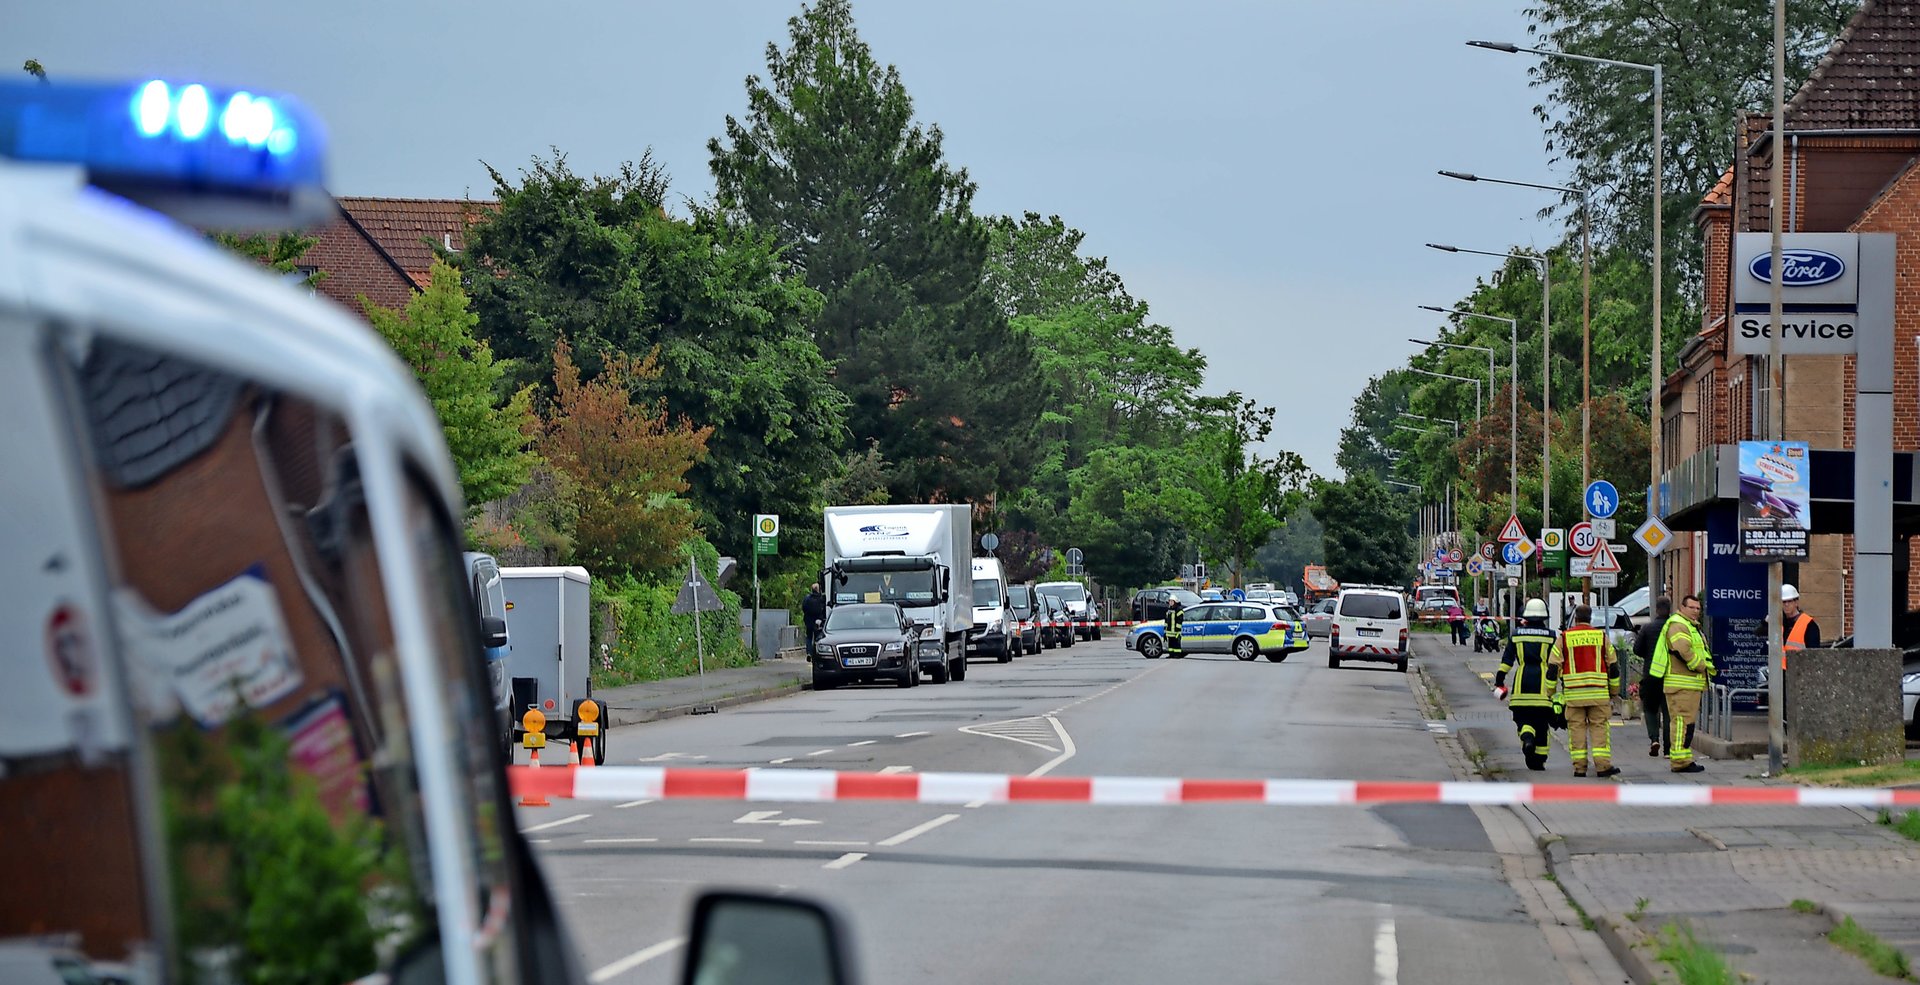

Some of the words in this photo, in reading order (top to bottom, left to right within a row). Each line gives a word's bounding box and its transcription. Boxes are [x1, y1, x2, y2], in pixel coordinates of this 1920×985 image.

[1769, 255, 1826, 278] Ford
[1741, 319, 1853, 339] Service
[1576, 532, 1595, 546] 30
[1712, 589, 1762, 599] SERVICE
[1736, 648, 1761, 656] Auspuff
